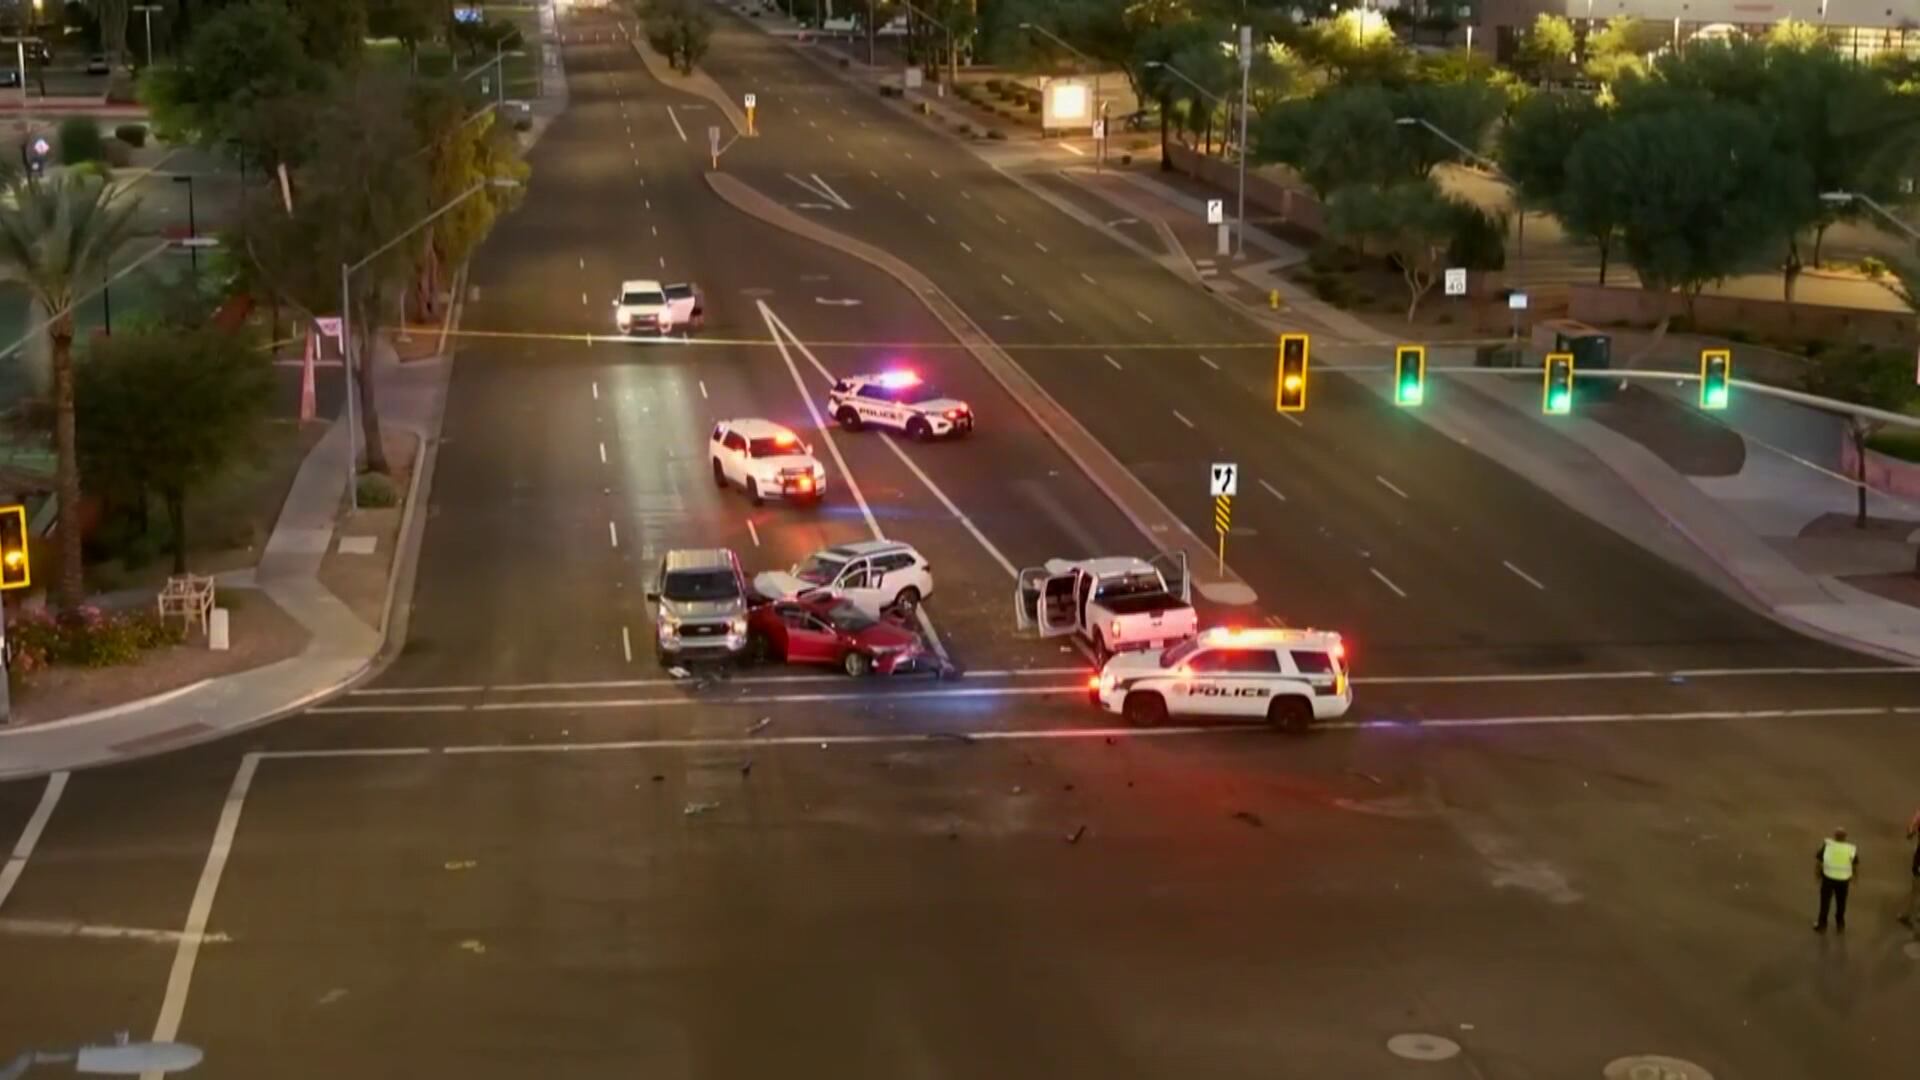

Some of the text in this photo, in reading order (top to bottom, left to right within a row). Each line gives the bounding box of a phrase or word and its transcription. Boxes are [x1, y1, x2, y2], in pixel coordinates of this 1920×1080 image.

[1448, 281, 1464, 292] 40
[859, 407, 897, 419] POLICE
[1188, 687, 1272, 698] POLICE
